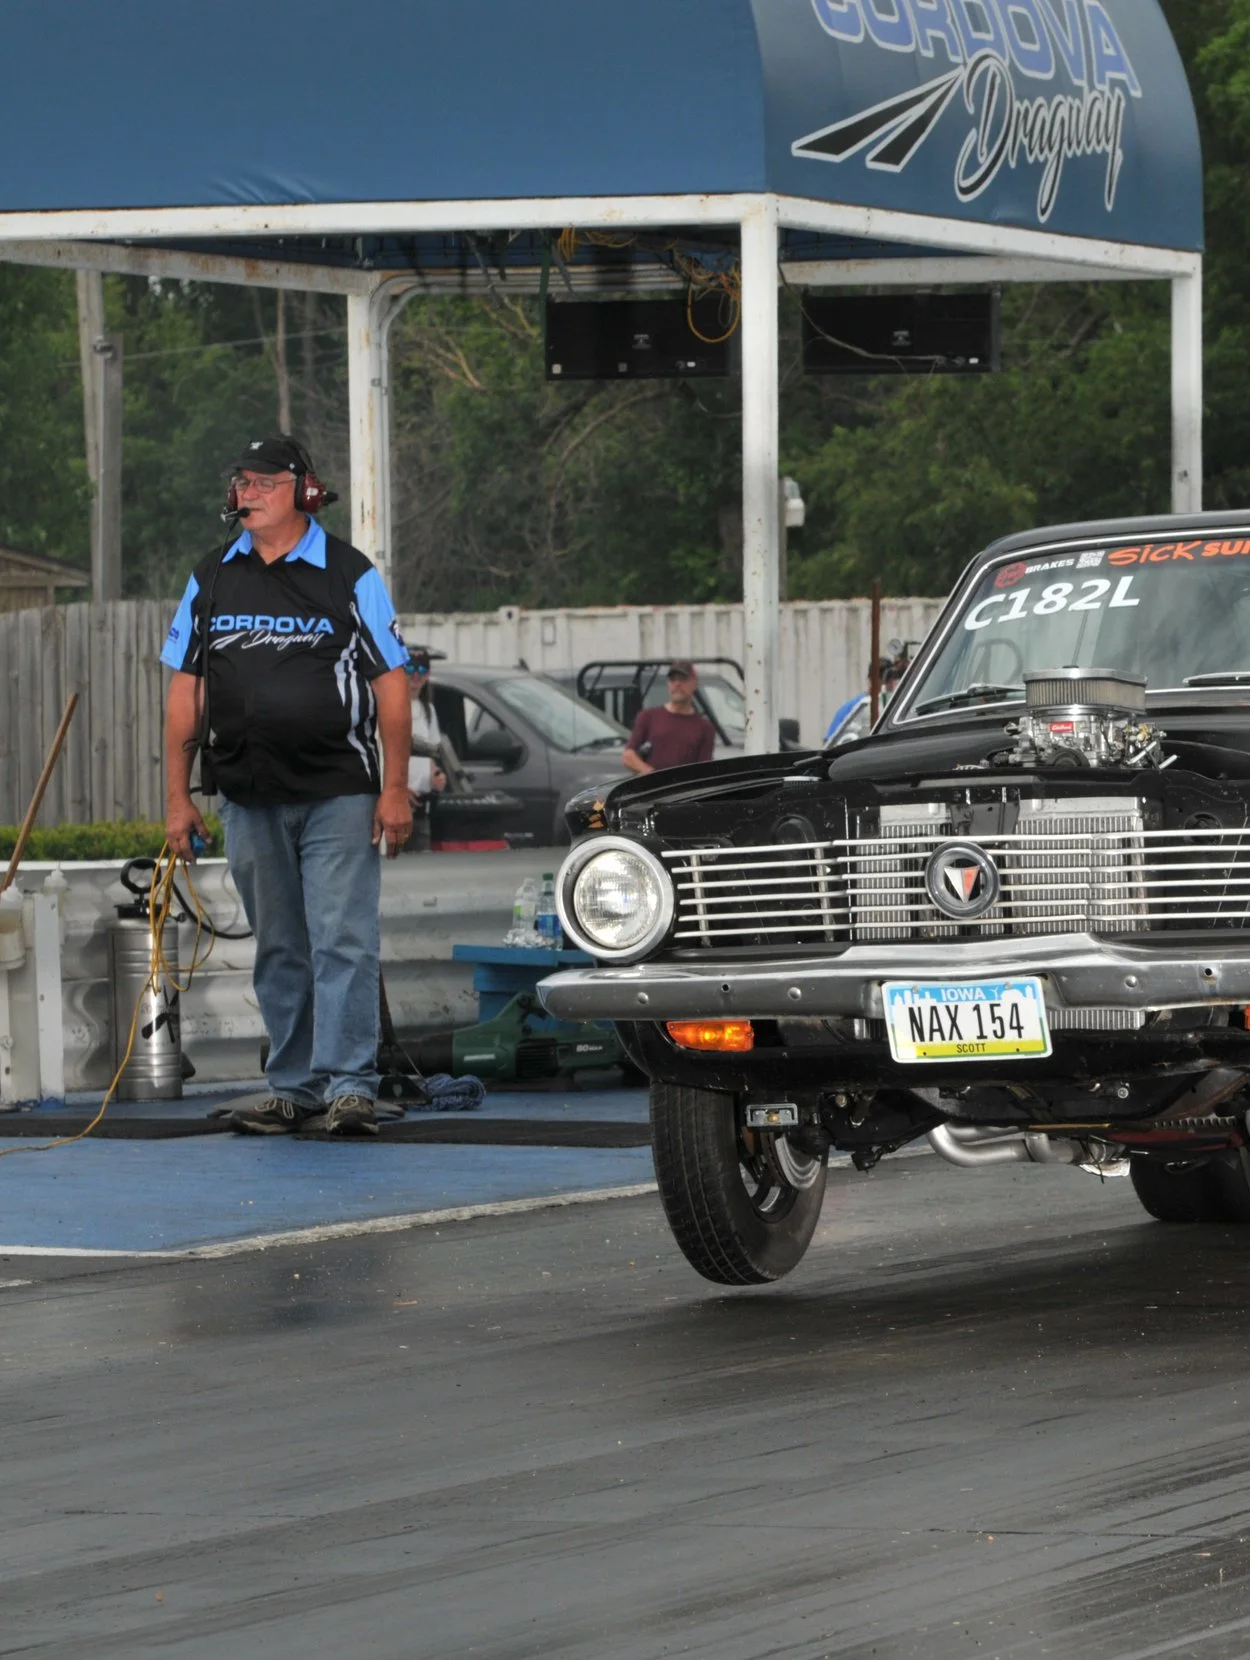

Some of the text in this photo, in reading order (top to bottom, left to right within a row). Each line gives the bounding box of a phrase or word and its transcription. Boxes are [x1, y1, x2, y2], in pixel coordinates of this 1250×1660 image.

[954, 48, 1125, 223] Dragway
[1025, 558, 1075, 574] BRAKES
[964, 576, 1140, 630] C182L
[241, 630, 325, 651] Dragway
[940, 988, 986, 1001] IOWA
[908, 1003, 1024, 1042] NAX 154
[956, 1043, 986, 1053] SCOTT
